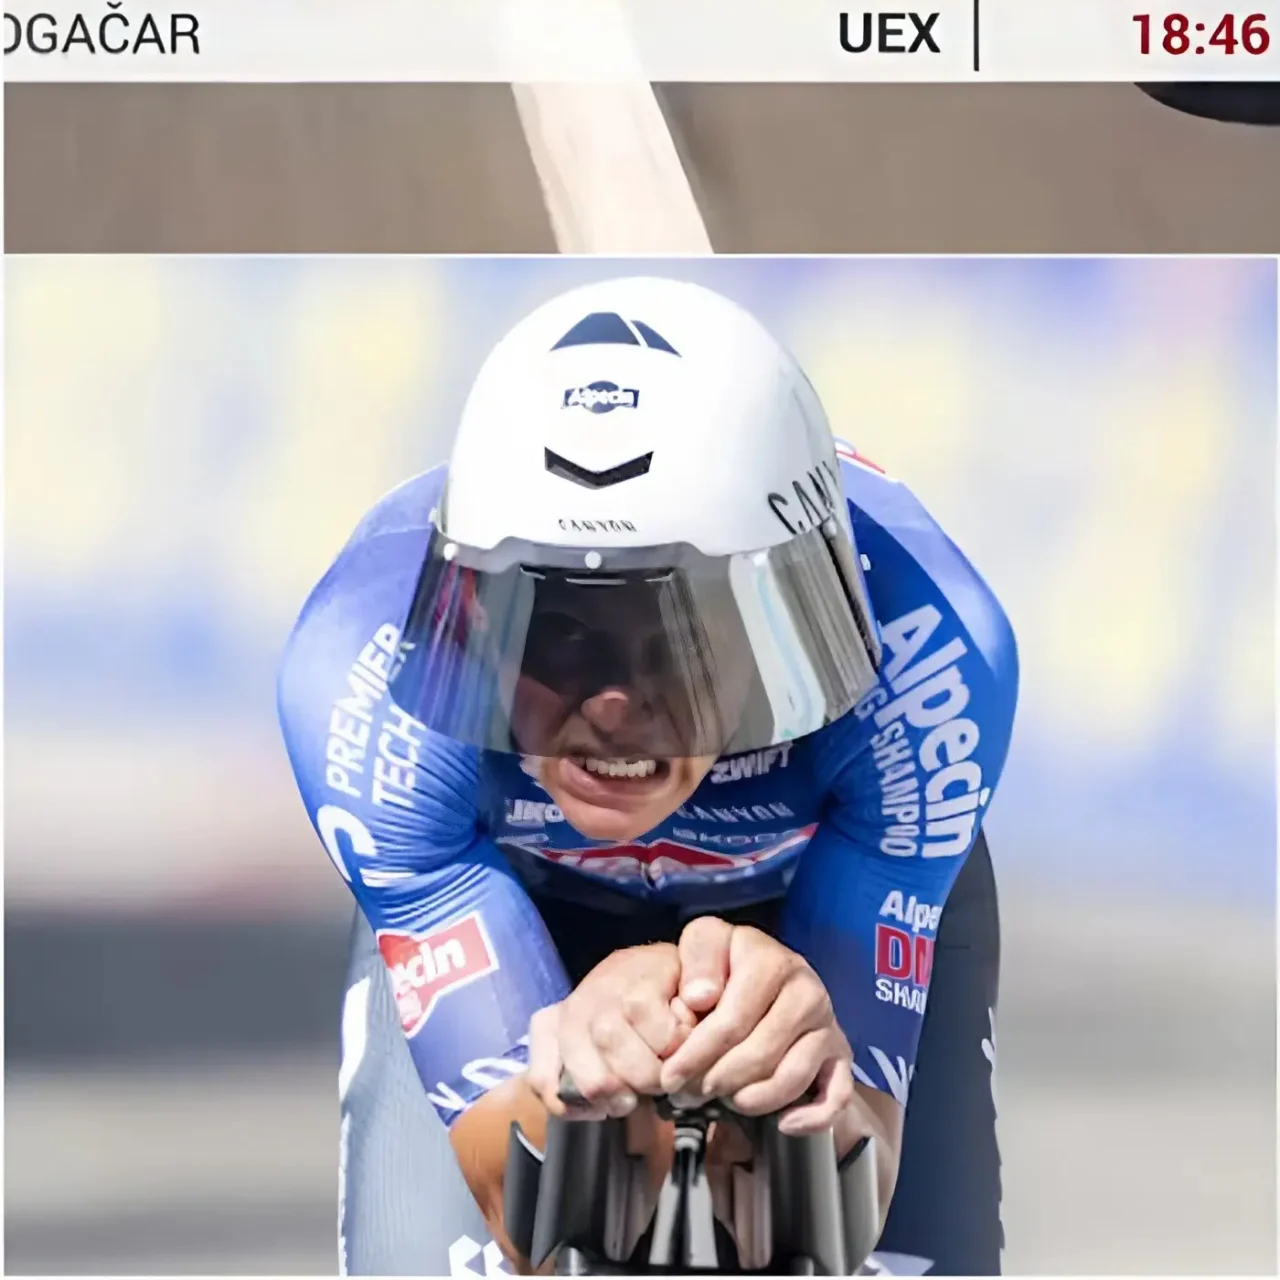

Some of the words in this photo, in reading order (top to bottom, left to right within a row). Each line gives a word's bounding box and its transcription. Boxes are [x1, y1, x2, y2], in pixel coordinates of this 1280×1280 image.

[325, 621, 412, 799] PREMIER
[371, 703, 428, 808] TECH
[881, 604, 990, 859] Alpecin
[869, 721, 918, 859] SHAMPOO
